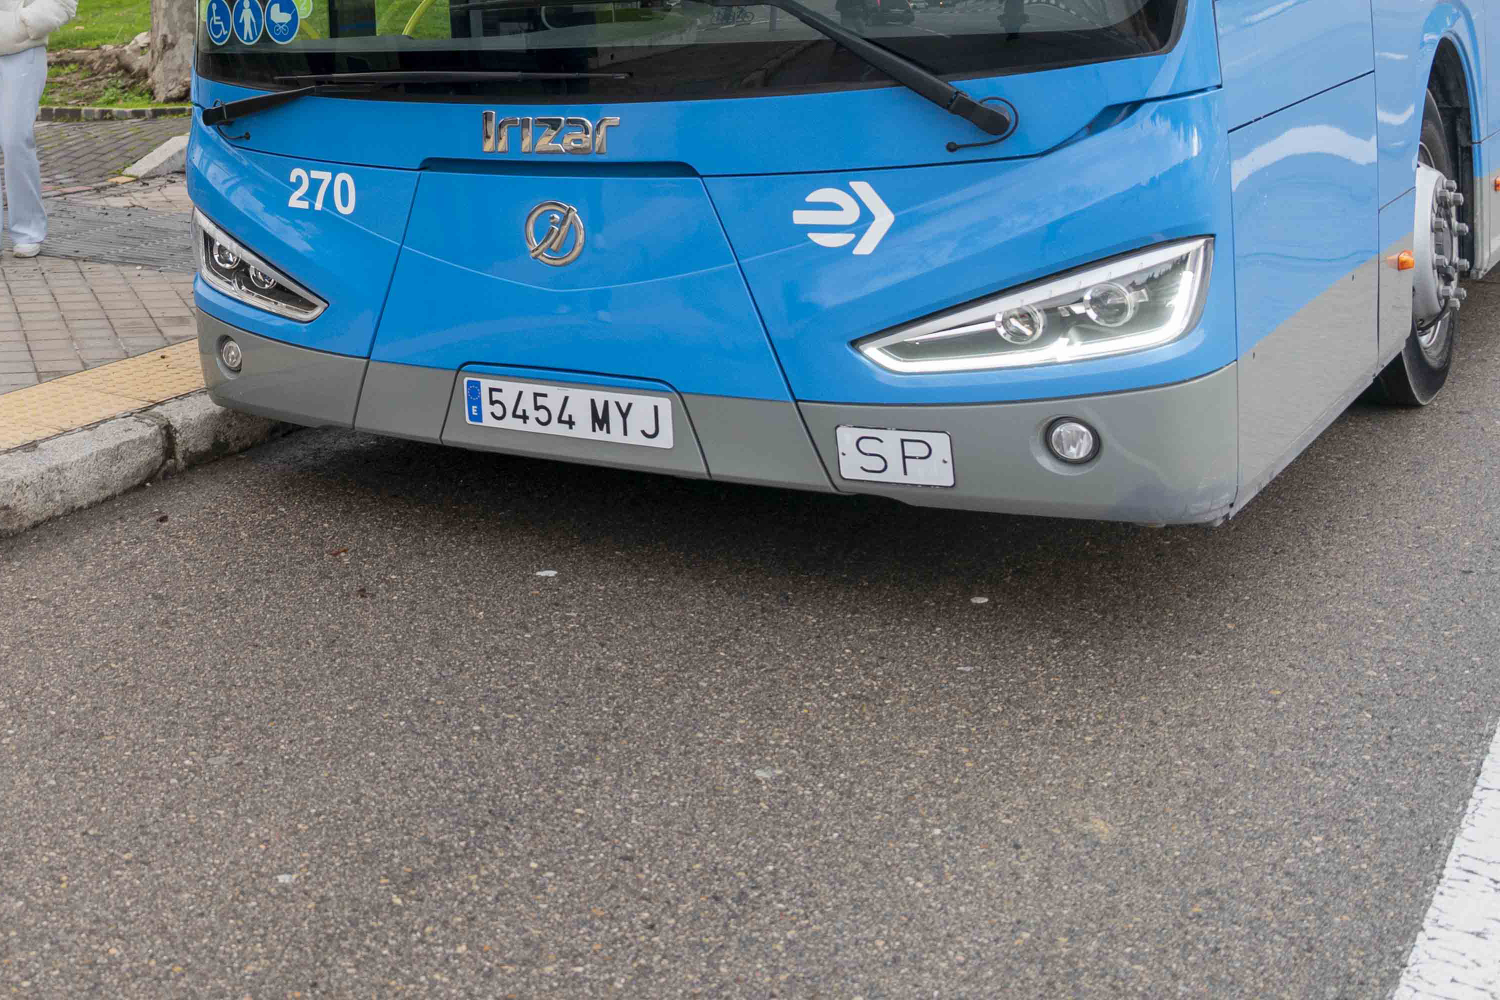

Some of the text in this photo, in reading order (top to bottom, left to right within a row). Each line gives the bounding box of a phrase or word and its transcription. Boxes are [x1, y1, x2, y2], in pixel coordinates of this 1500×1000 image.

[288, 167, 356, 215] 270
[471, 387, 660, 439] E 5454 MYJ
[855, 434, 933, 478] SP
